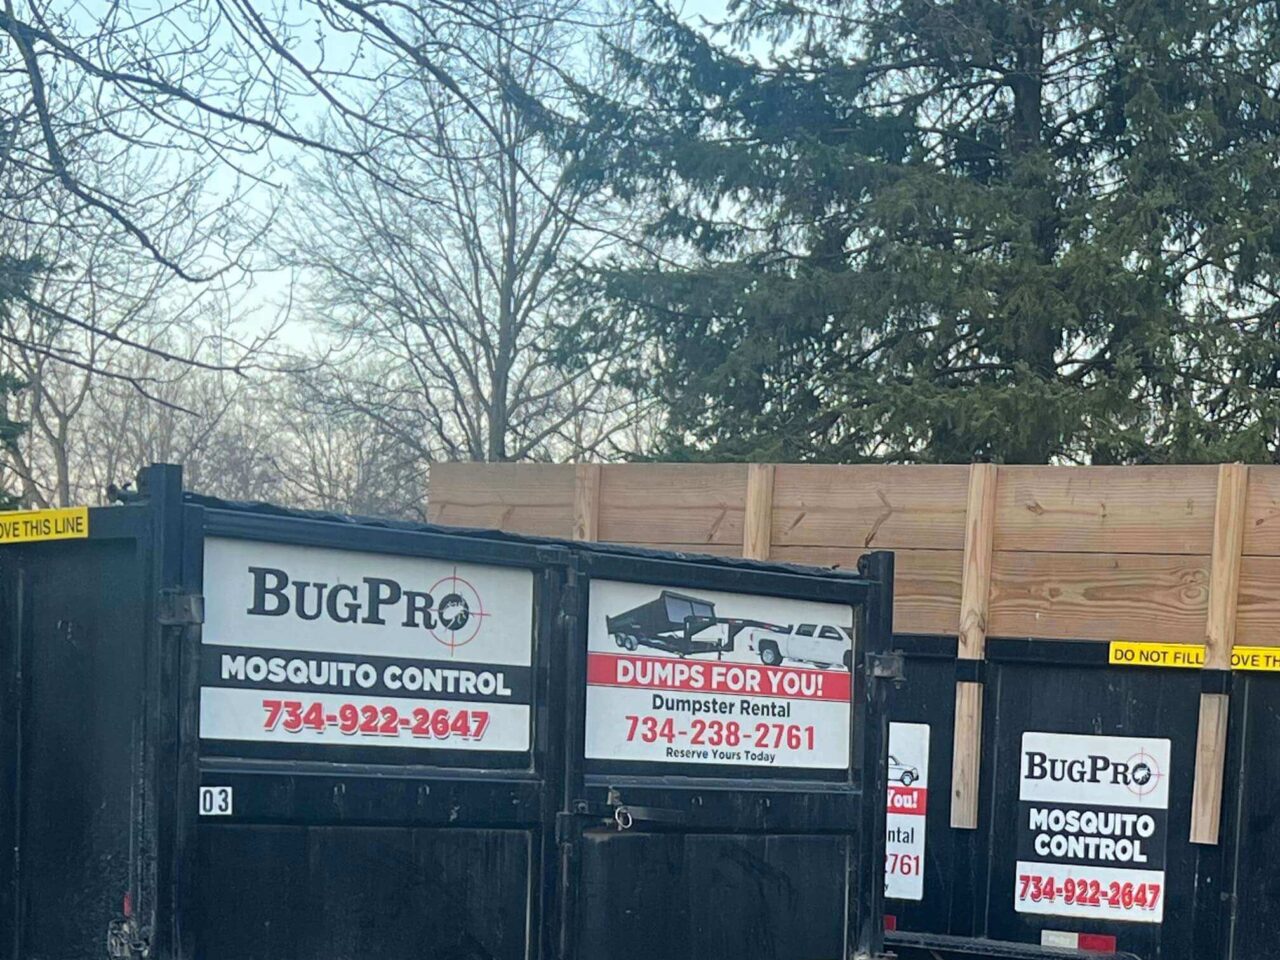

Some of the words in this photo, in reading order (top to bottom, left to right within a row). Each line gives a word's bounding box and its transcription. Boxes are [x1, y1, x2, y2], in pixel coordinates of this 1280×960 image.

[0, 520, 20, 538] OVE
[22, 518, 51, 537] THIS
[55, 516, 84, 535] LINE
[1114, 648, 1135, 662] DO
[1139, 650, 1168, 664] NOT
[1173, 652, 1204, 665] FILL
[1231, 653, 1260, 668] OVE
[222, 654, 378, 689] MOSQUITO
[383, 666, 512, 697] CONTROL
[616, 659, 705, 689] DUMPS
[711, 666, 761, 692] FOR
[767, 670, 823, 696] YOU!
[652, 693, 735, 718] Dumpster
[740, 700, 791, 718] Rental
[262, 700, 490, 741] 734-922-2647
[625, 716, 815, 750] 734-238-2761
[666, 747, 709, 760] Reserve
[711, 749, 742, 762] Yours
[744, 750, 776, 764] Today
[203, 788, 229, 813] 03
[887, 827, 914, 844] ntal
[1029, 808, 1155, 838] MOSQUITO
[1034, 838, 1148, 863] CONTROL
[1019, 875, 1161, 911] 734-922-2647
